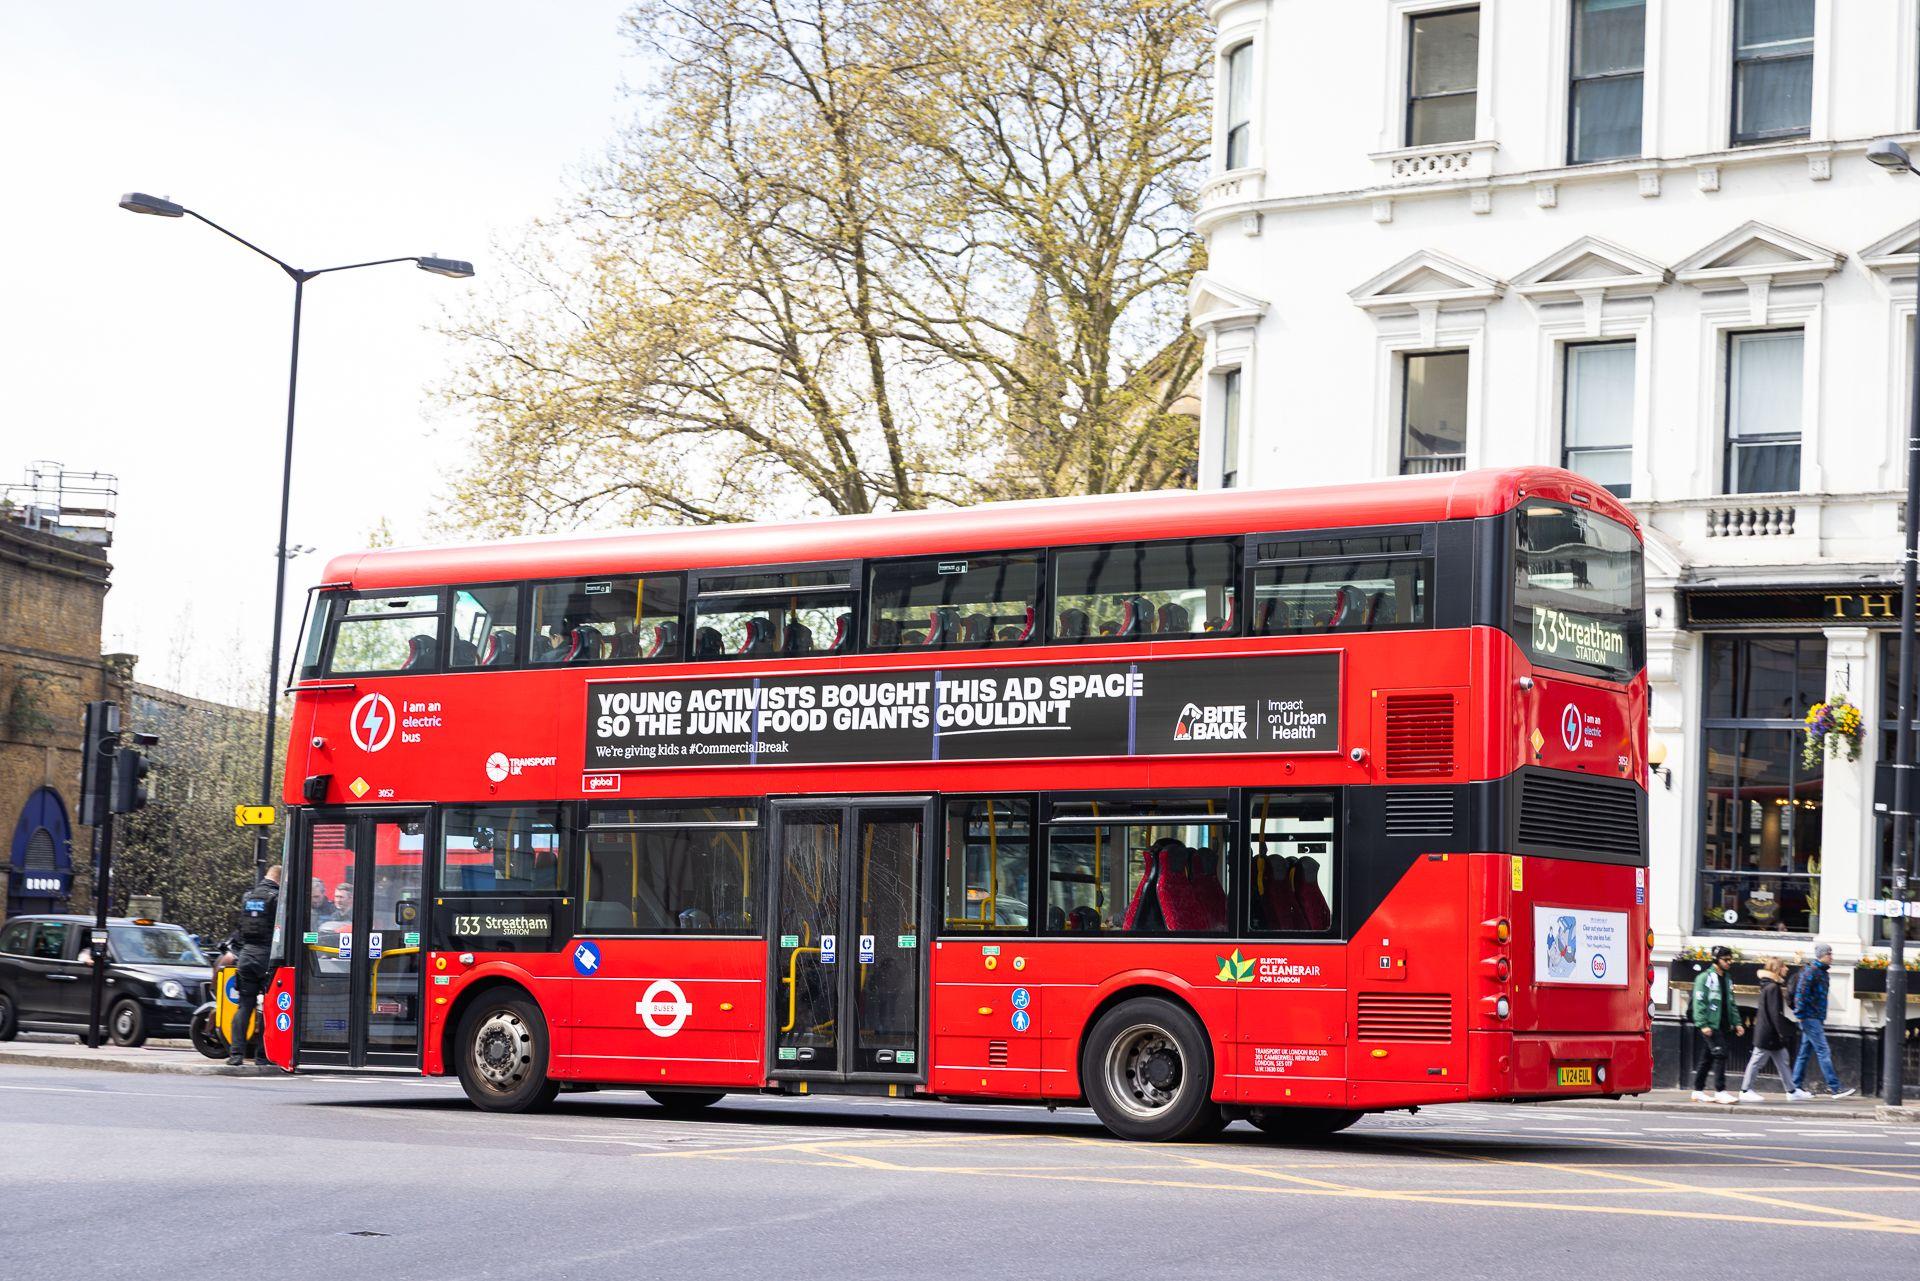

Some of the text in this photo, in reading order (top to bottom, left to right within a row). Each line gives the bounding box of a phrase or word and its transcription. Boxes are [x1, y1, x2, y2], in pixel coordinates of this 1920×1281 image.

[1824, 594, 1920, 617] TH
[1558, 612, 1623, 654] Streatham
[1575, 645, 1606, 664] STATION
[598, 673, 1144, 715] YOUNG ACTIVISTS BOUGHT THIS AD SPACE
[403, 701, 441, 712] I am an
[1268, 699, 1304, 712] Impact
[596, 700, 1071, 738] SO THE JUNK FOOD GIANTS COULDN'T
[1203, 705, 1246, 724] BITE
[1268, 711, 1327, 726] on Urban
[1587, 715, 1595, 724] am
[1595, 716, 1601, 725] an
[402, 716, 442, 728] electric
[401, 731, 421, 743] bus
[1193, 721, 1248, 741] BACK
[1272, 725, 1316, 740] Health
[1584, 726, 1602, 737] electric
[1584, 737, 1593, 748] bus
[596, 741, 789, 759] We're giving kids a #CommercialBreak
[509, 757, 557, 767] TRANSPORT
[509, 766, 522, 775] UK
[590, 777, 613, 790] global
[377, 789, 395, 798] 3052
[455, 916, 548, 935] 133 Streatham
[502, 928, 530, 936] STATION
[1593, 960, 1604, 971] Esso
[1273, 976, 1301, 984] LONDON
[1579, 1069, 1590, 1083] EUL
